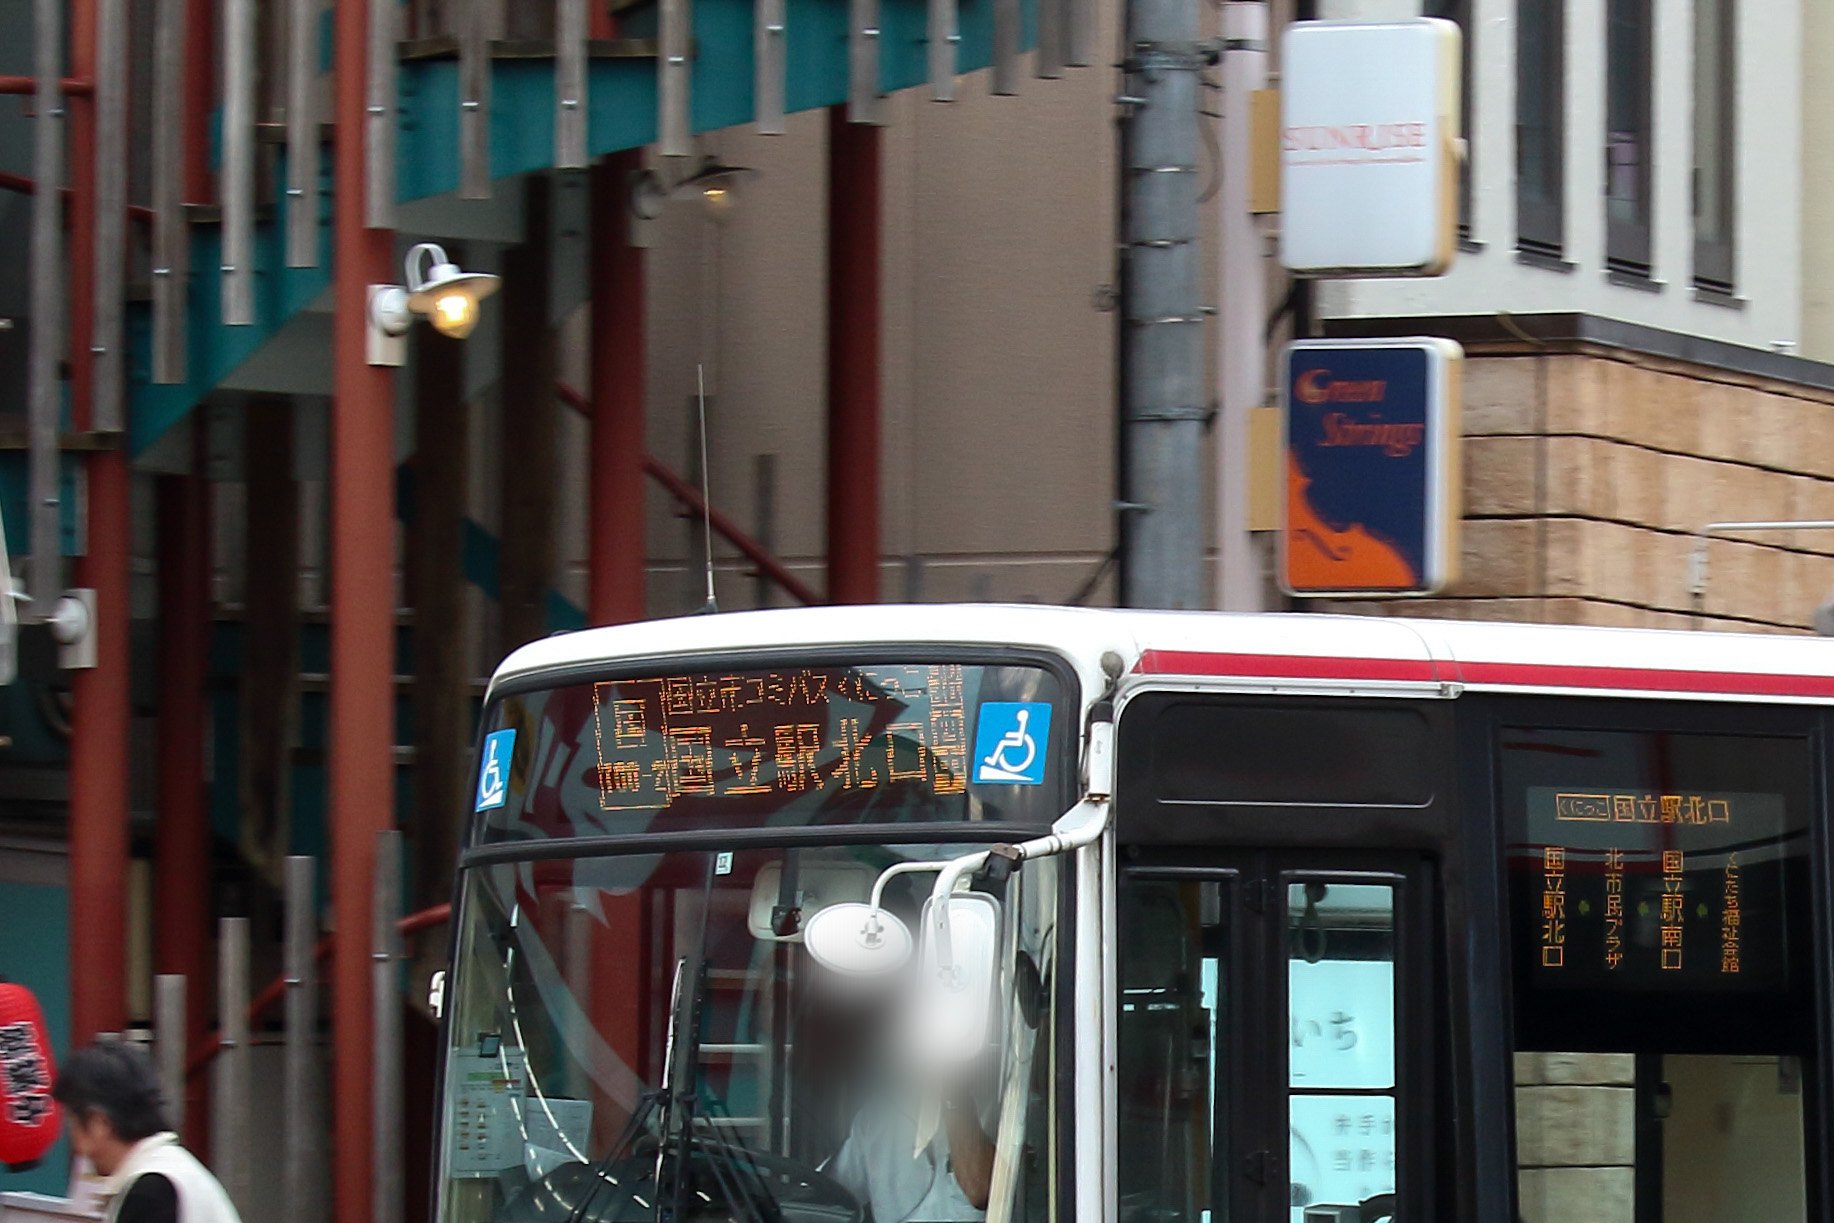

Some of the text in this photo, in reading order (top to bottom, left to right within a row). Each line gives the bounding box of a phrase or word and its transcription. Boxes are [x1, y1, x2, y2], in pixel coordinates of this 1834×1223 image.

[668, 717, 928, 796] 国立駅北口
[1613, 795, 1729, 824] 国立駅北口
[1542, 847, 1566, 968] 国立駅北口
[1605, 847, 1624, 970] 北市民プラザ
[1660, 850, 1684, 970] 国立駅南口
